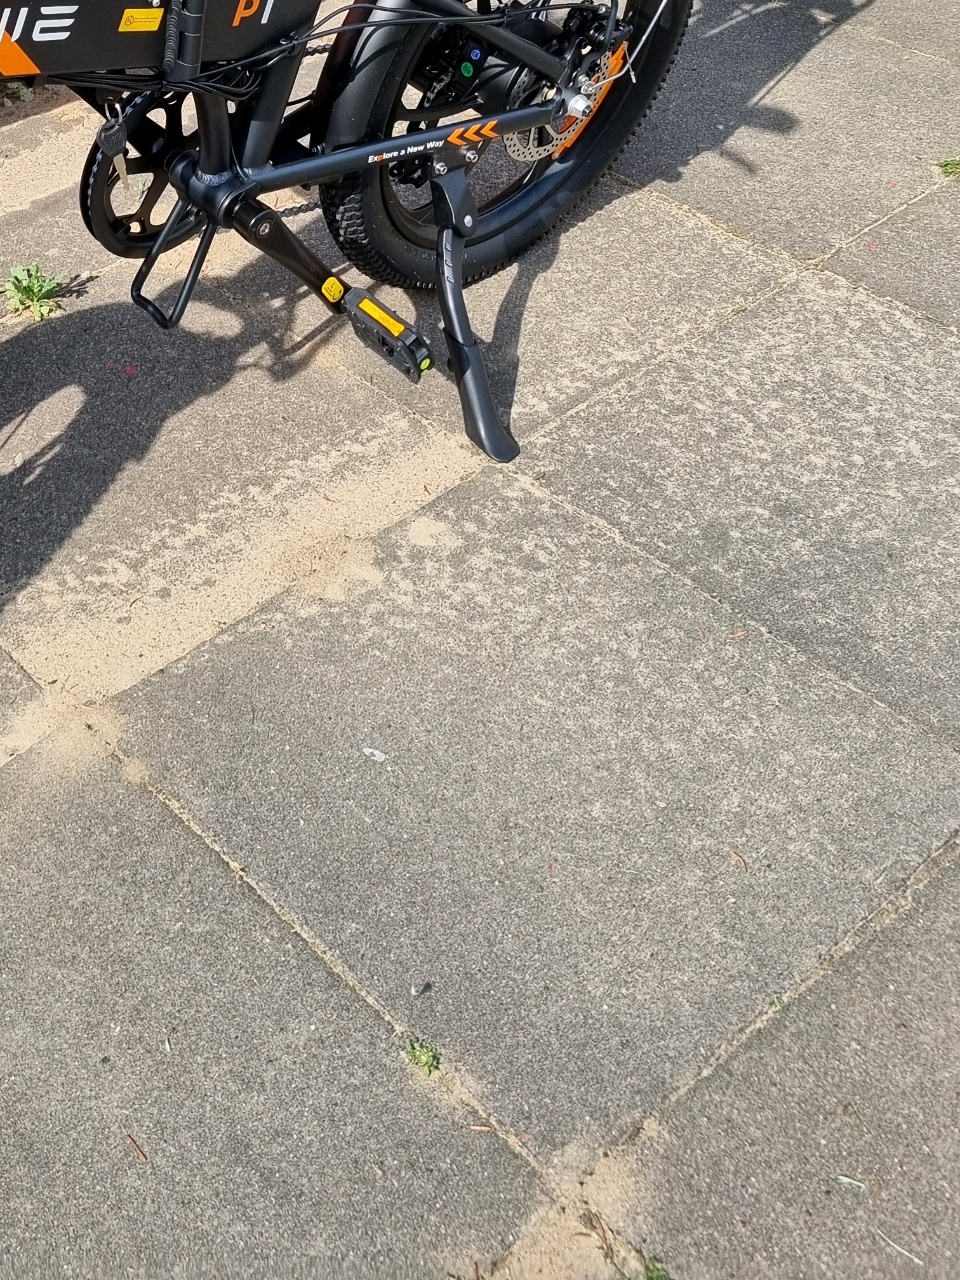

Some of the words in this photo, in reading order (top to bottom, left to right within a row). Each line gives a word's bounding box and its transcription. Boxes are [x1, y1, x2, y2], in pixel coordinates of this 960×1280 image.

[368, 151, 399, 164] Explore
[407, 144, 425, 154] New
[426, 140, 445, 150] Way
